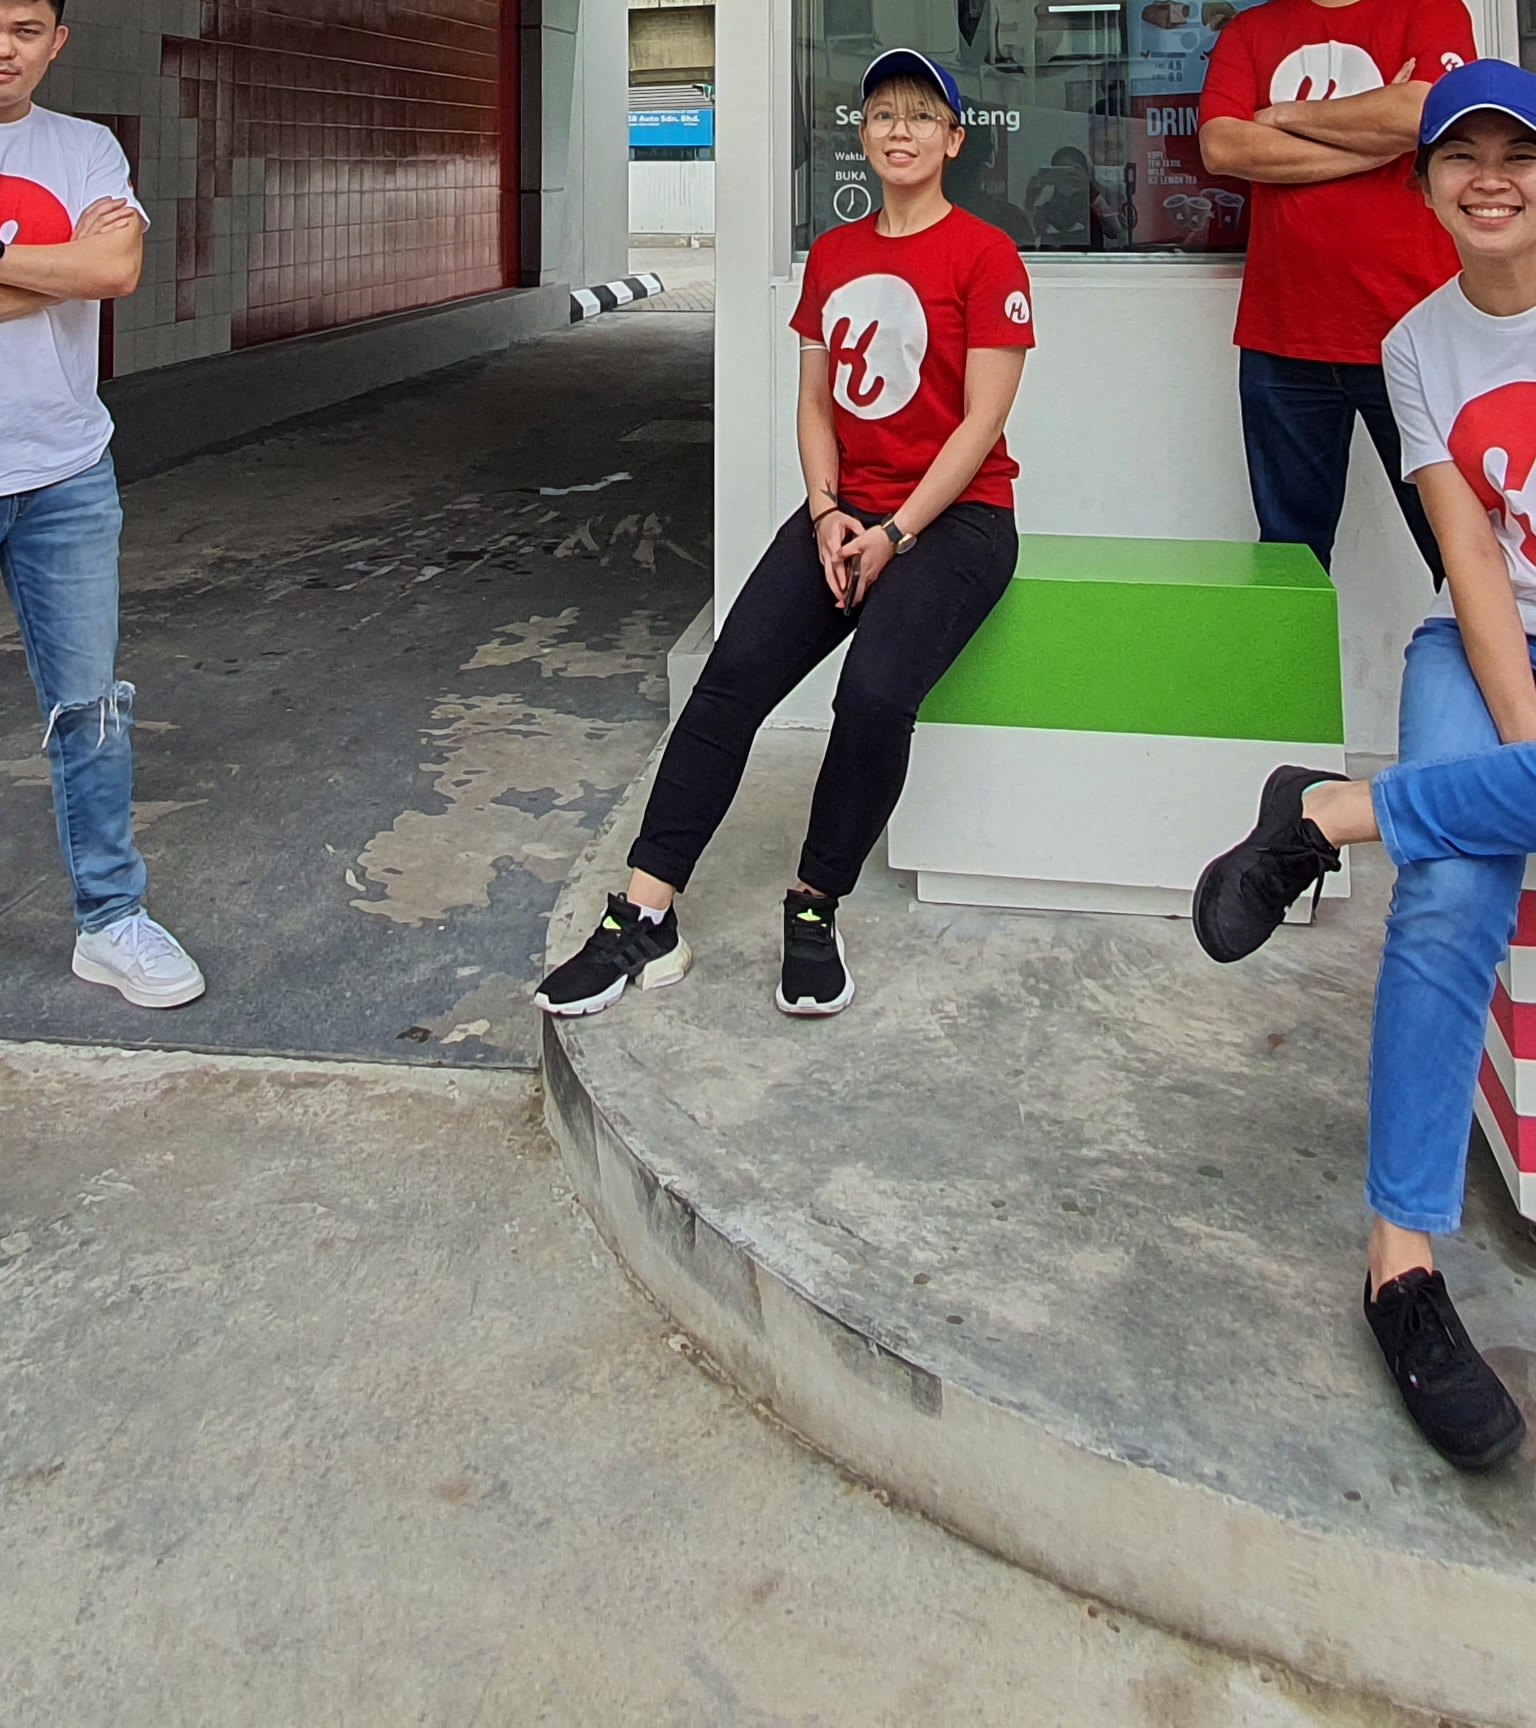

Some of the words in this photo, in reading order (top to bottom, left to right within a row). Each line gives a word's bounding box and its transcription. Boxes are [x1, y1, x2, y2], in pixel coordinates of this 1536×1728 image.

[1146, 107, 1198, 136] DRIN
[835, 152, 866, 161] Waktu
[835, 171, 867, 181] BUKA
